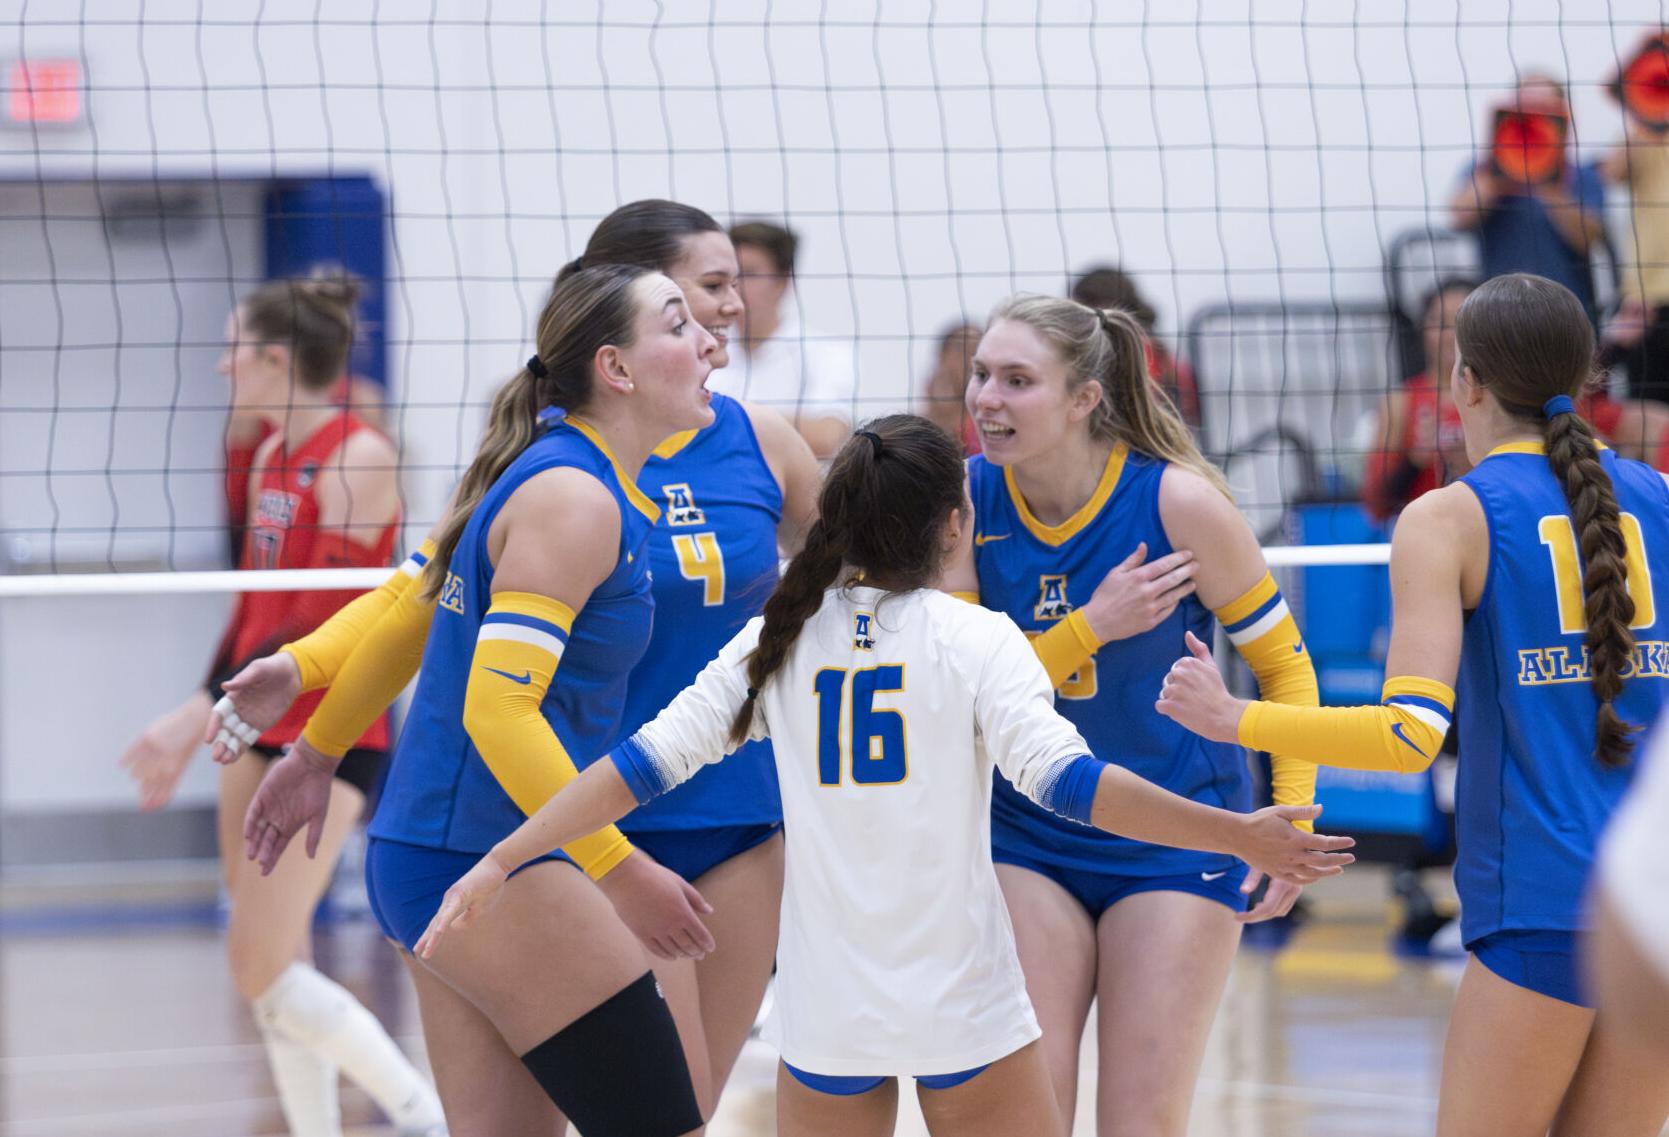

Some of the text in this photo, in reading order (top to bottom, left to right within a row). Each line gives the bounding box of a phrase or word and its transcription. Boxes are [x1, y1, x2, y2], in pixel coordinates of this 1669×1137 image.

[662, 483, 706, 526] A
[671, 532, 725, 607] 4
[1034, 575, 1072, 620] A
[853, 611, 876, 652] A
[812, 662, 908, 788] 16
